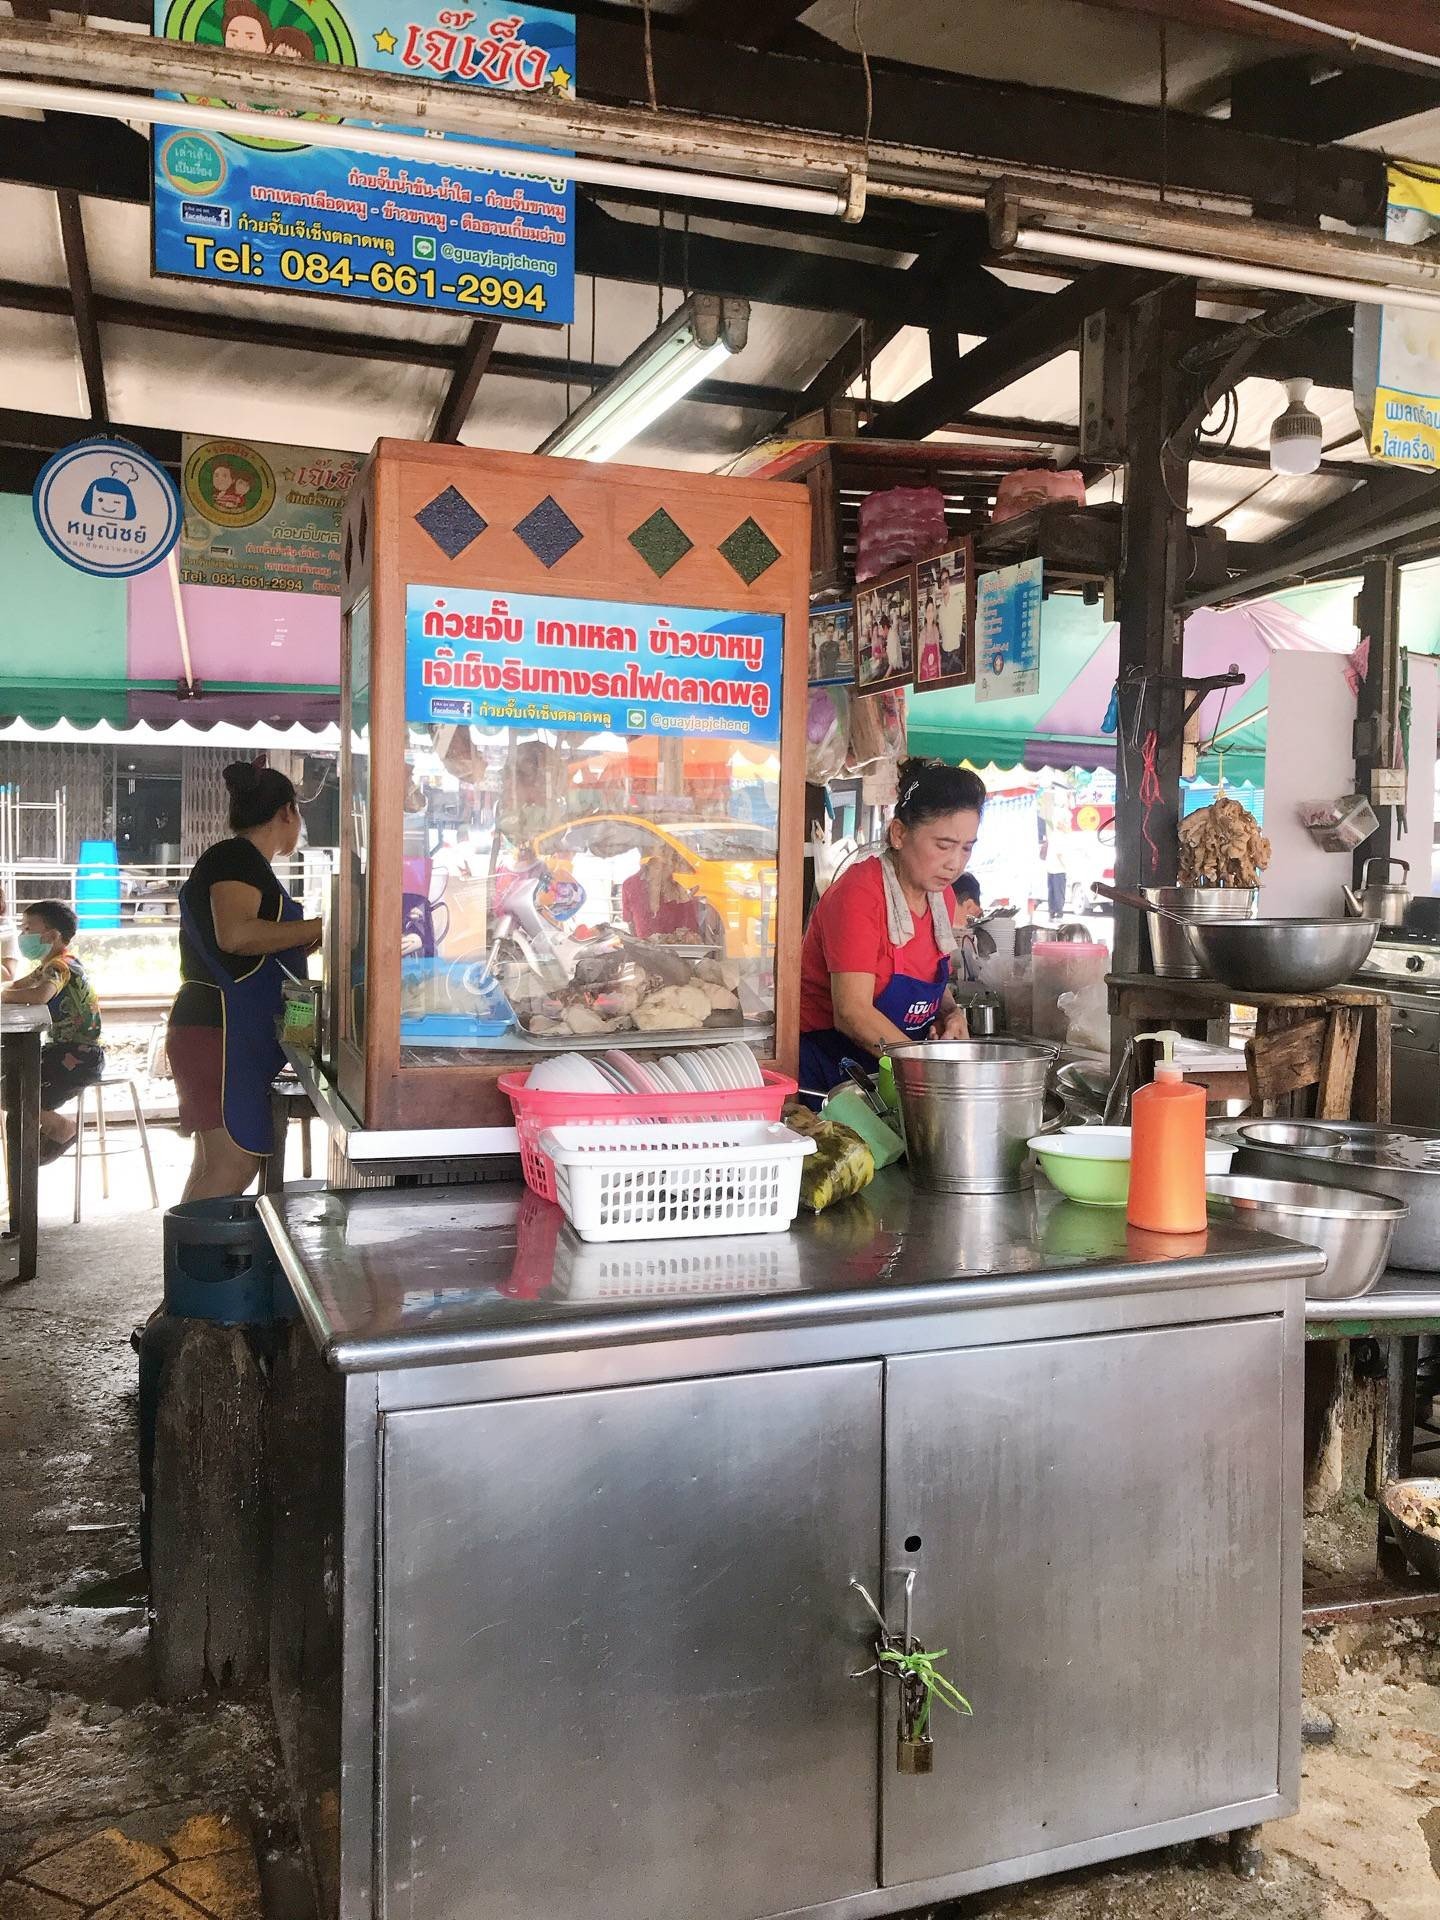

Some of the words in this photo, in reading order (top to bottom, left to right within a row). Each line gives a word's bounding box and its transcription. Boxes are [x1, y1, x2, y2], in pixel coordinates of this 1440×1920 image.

[400, 9, 551, 90] เจ๊เช็ง
[251, 185, 367, 221] เกาเหลาเลือดหมู
[382, 202, 447, 232] ข้าวขาหมู
[486, 189, 566, 223] ก๋วยจั๊บขาหมู
[238, 212, 395, 256] ก๋วยจั๊บเจ๊เช็งตลาดพลู
[185, 235, 263, 276] Tel:
[279, 249, 546, 312] 084-661-2994
[441, 243, 557, 276] @guayjapjcheng
[296, 458, 357, 490] เจ๊เช็
[67, 520, 147, 543] หนูณิชย์
[181, 569, 207, 583] Tel:
[211, 573, 304, 591] 084-661-2994
[423, 599, 523, 644] ก๋วยจั๊บ
[535, 617, 637, 653] เกาเหลา
[649, 618, 763, 672] ข้าวขาหมู
[422, 647, 771, 717] เจ๊เช็งริมทางรถไฟตลาดพลู
[479, 698, 611, 729] ก๋วยจั๊บเจ๊เช็งตลาดพลู
[651, 713, 750, 734] @guayjapjcheng
